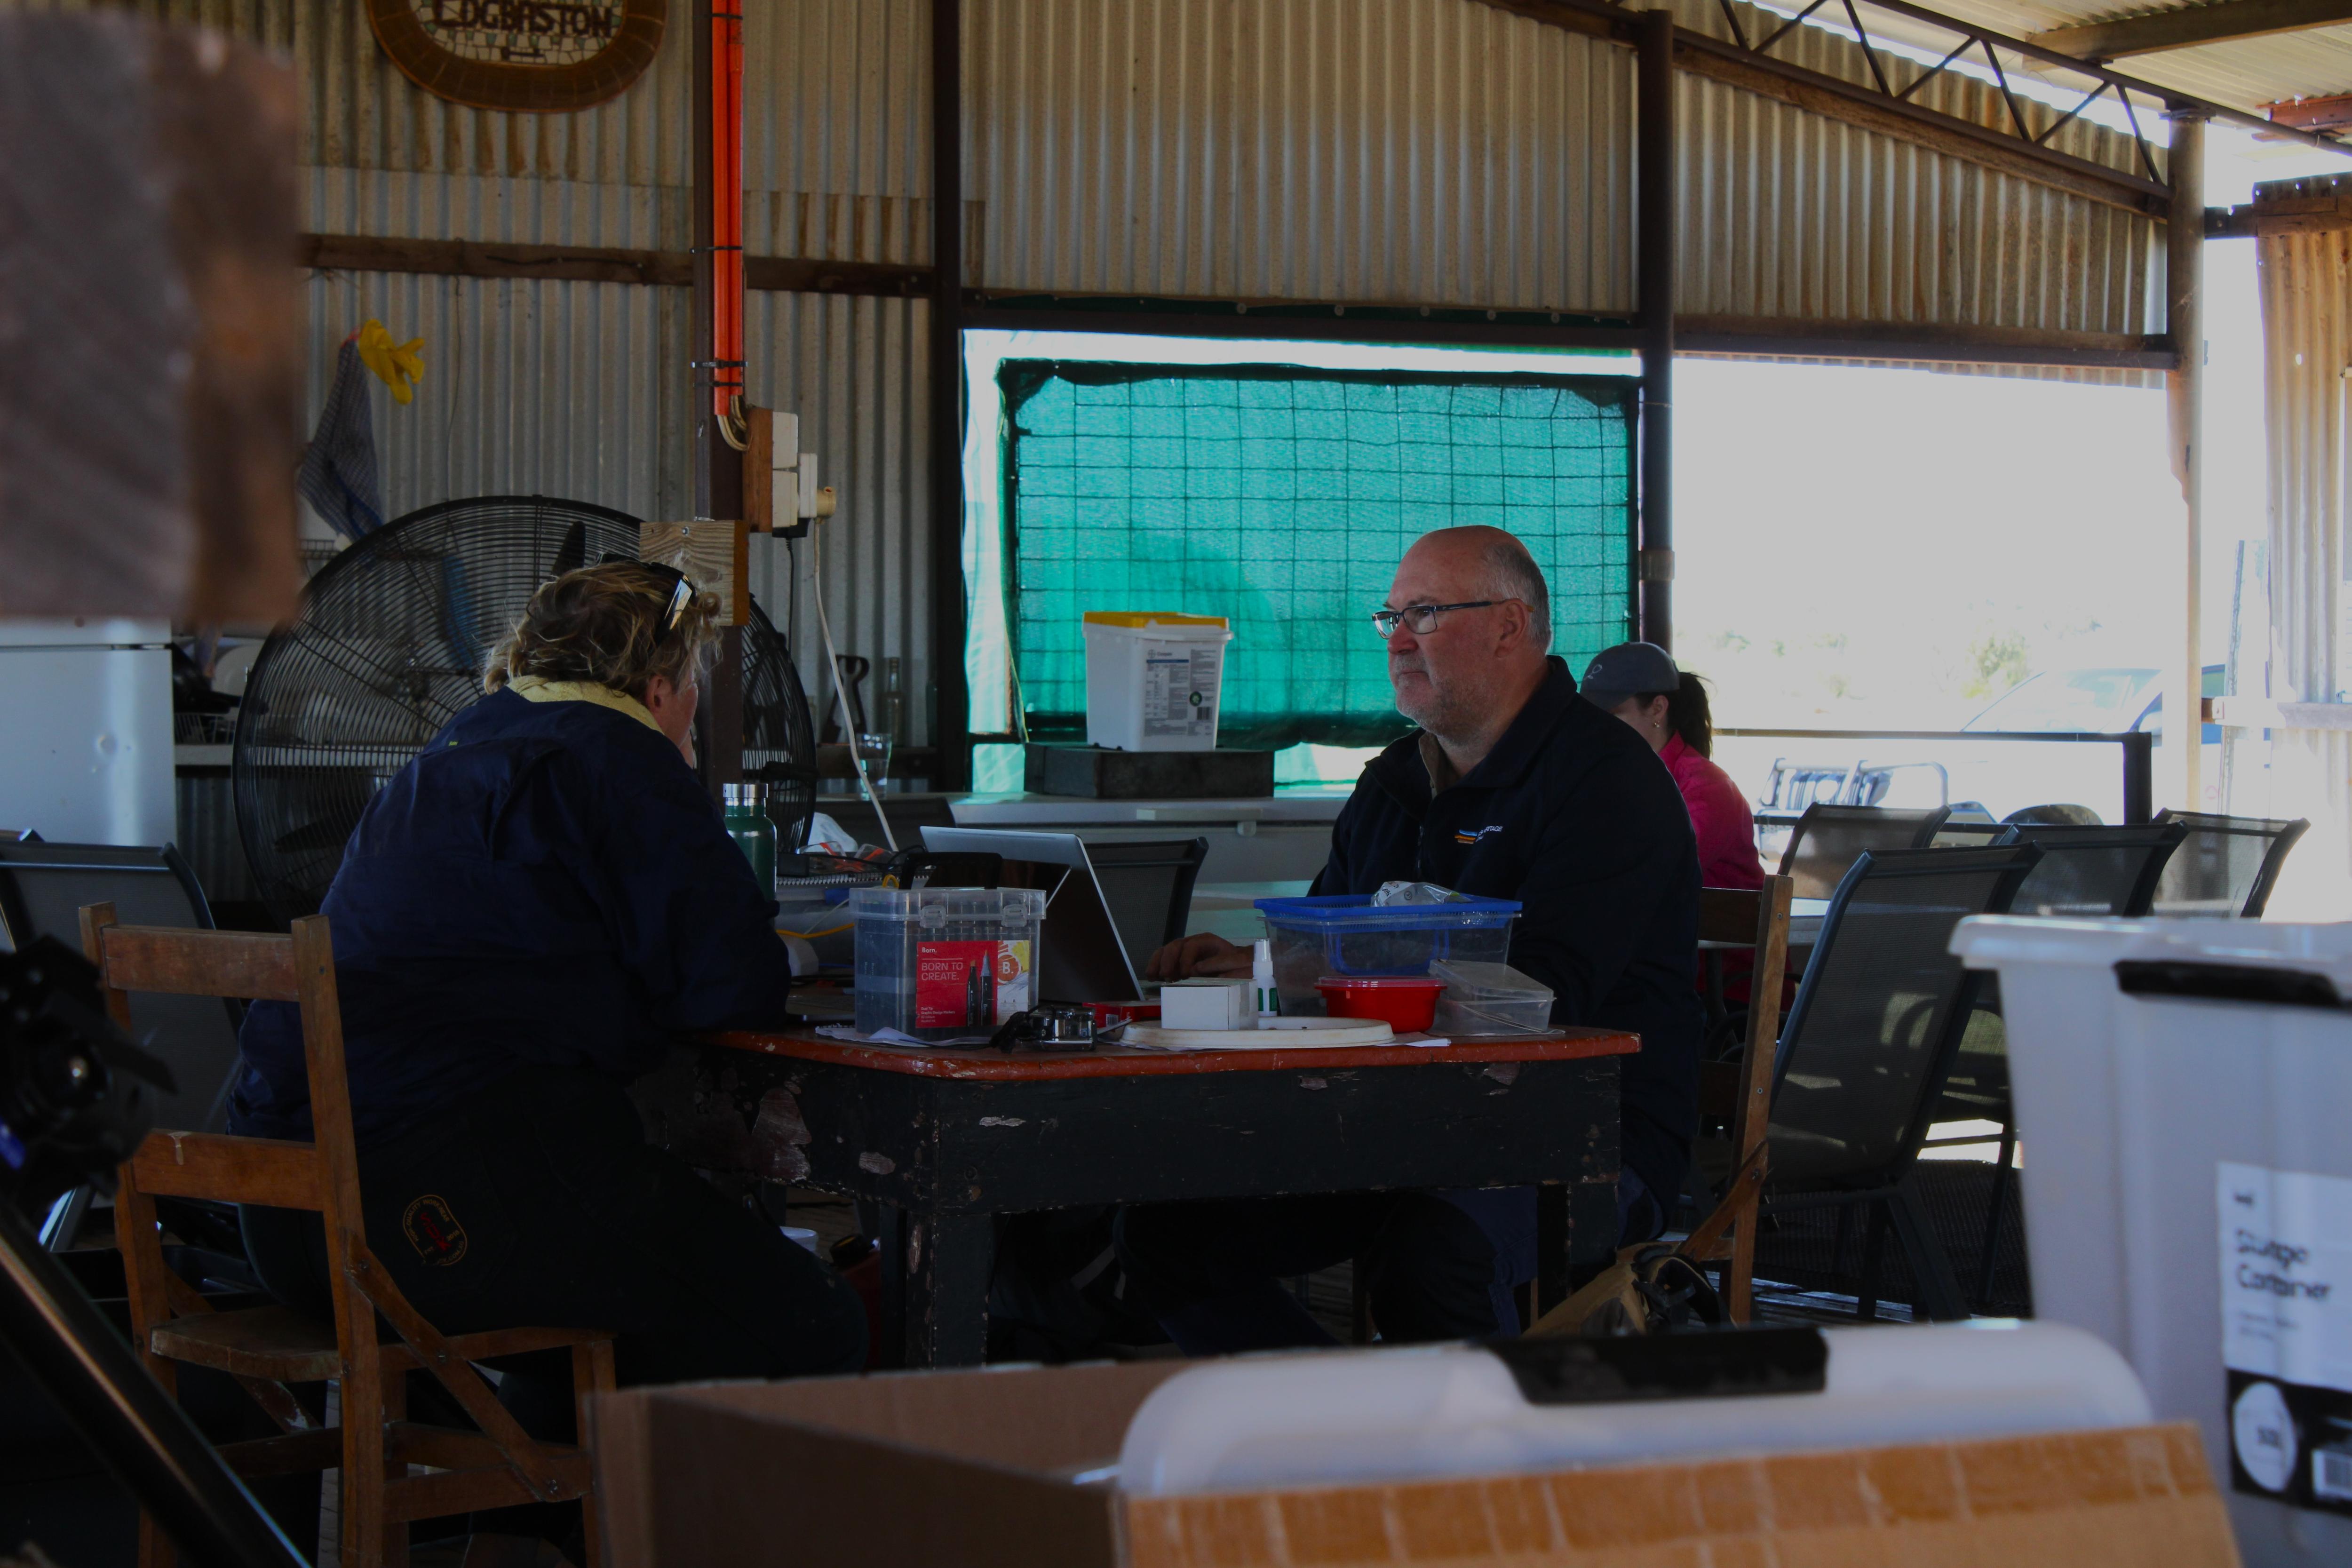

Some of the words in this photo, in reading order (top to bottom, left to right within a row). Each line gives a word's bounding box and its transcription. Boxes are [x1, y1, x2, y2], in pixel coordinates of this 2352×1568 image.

[922, 963, 948, 971] BORN
[952, 962, 963, 971] TO
[922, 971, 960, 980] CREATE.
